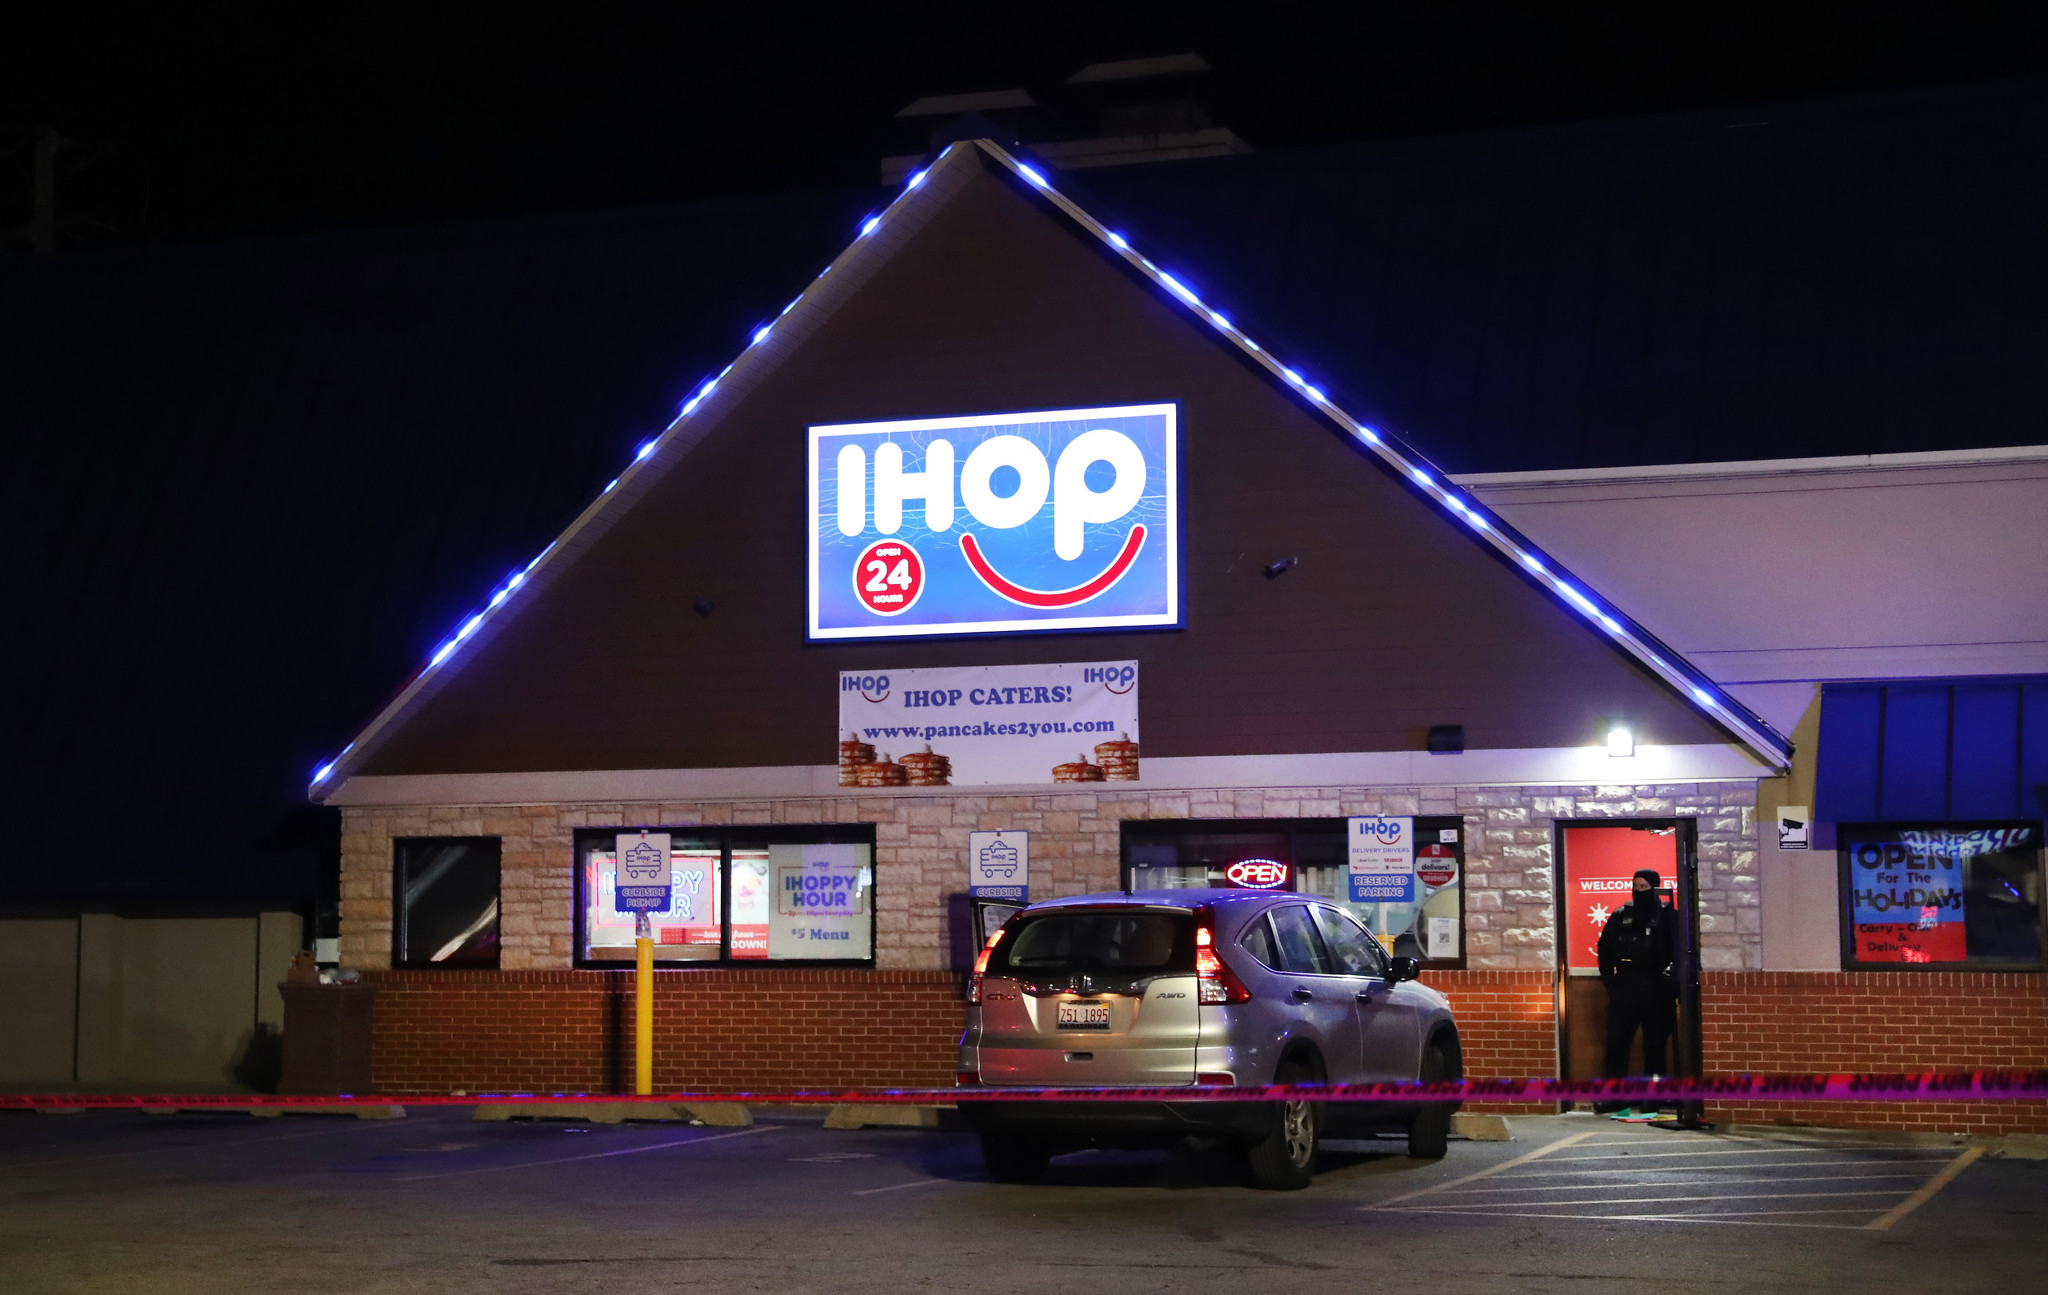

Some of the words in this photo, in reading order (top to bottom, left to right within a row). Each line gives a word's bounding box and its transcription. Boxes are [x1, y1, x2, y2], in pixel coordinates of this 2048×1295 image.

[838, 429, 1146, 561] IHOP
[876, 548, 901, 557] OPEN
[865, 559, 913, 592] 24
[873, 594, 903, 603] HOURS
[1084, 666, 1135, 687] IHOP
[842, 675, 890, 695] IHOP
[904, 689, 963, 708] IHOP
[969, 685, 1072, 705] CATERS!
[864, 720, 1115, 740] www.pancakes2you.com
[1360, 822, 1401, 839] IHOP
[1857, 844, 1954, 870] OPEN
[1227, 865, 1287, 882] OPEN
[1876, 872, 1899, 884] For
[1906, 872, 1932, 883] The
[785, 875, 856, 891] IHOPPY
[1354, 876, 1408, 885] RESERVED
[1581, 881, 1633, 890] WELCOM
[622, 887, 666, 897] CURBSIDE
[976, 887, 1022, 897] CURBSIDE
[1359, 887, 1404, 897] PARKING
[793, 892, 847, 907] HOUR
[810, 928, 849, 940] Menu
[1859, 924, 1893, 934] Carry
[1898, 933, 1908, 942] &
[731, 940, 767, 949] DOWN!
[1061, 1009, 1077, 1022] Z51
[1084, 1009, 1108, 1022] 1895
